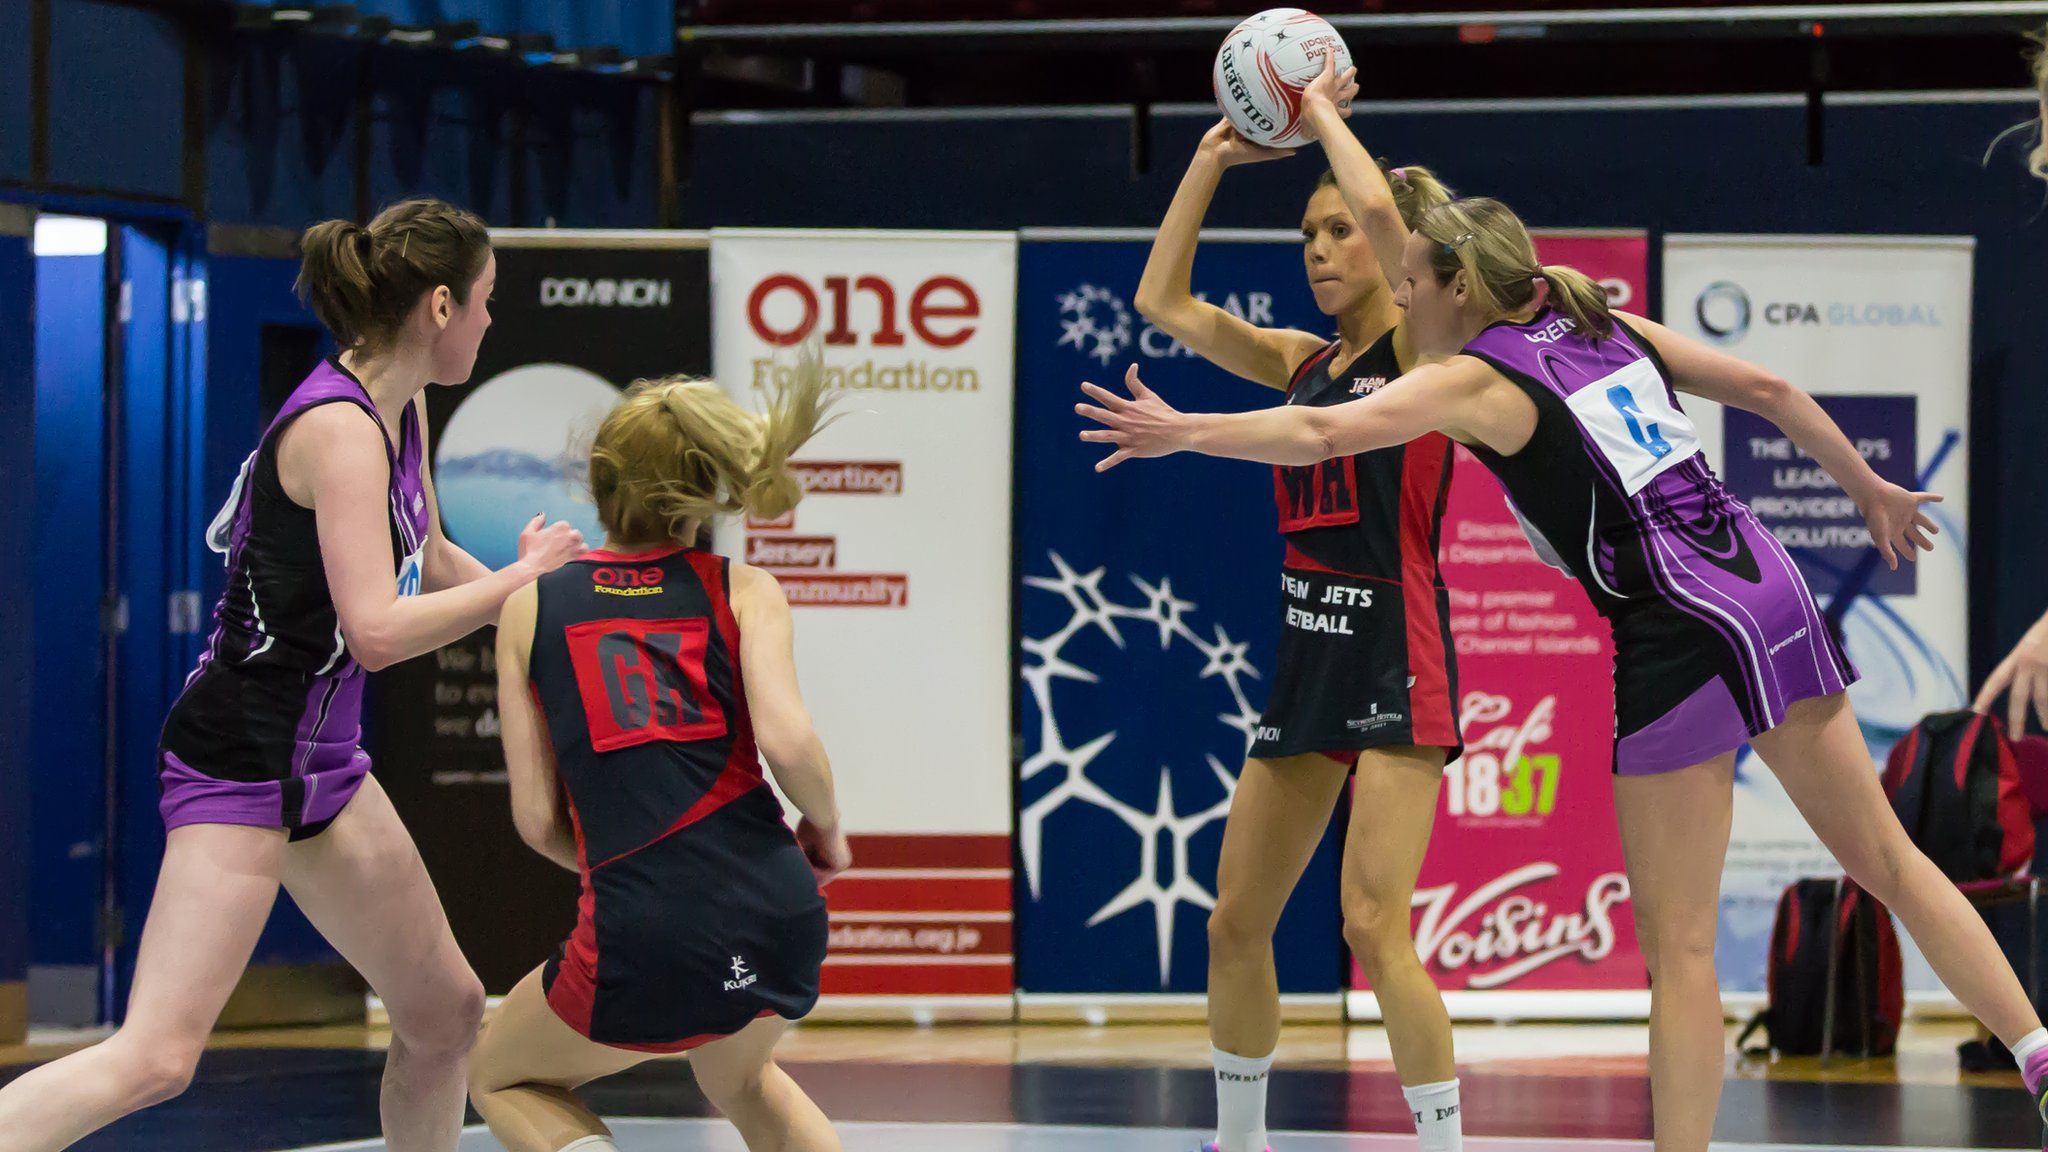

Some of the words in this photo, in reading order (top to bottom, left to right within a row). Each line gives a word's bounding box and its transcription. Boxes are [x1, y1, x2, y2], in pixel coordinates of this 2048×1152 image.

[1221, 45, 1275, 132] GILBERT
[746, 273, 981, 347] one
[1764, 303, 1820, 326] CPA
[1827, 303, 1942, 326] GLOBAL
[752, 359, 980, 391] Fondation
[1750, 439, 1791, 459] THE
[749, 538, 832, 569] Jersey
[592, 567, 665, 586] one
[594, 584, 663, 597] Foundation
[1320, 585, 1374, 608] JETS
[596, 631, 704, 730] GA
[1444, 754, 1560, 816] 1837
